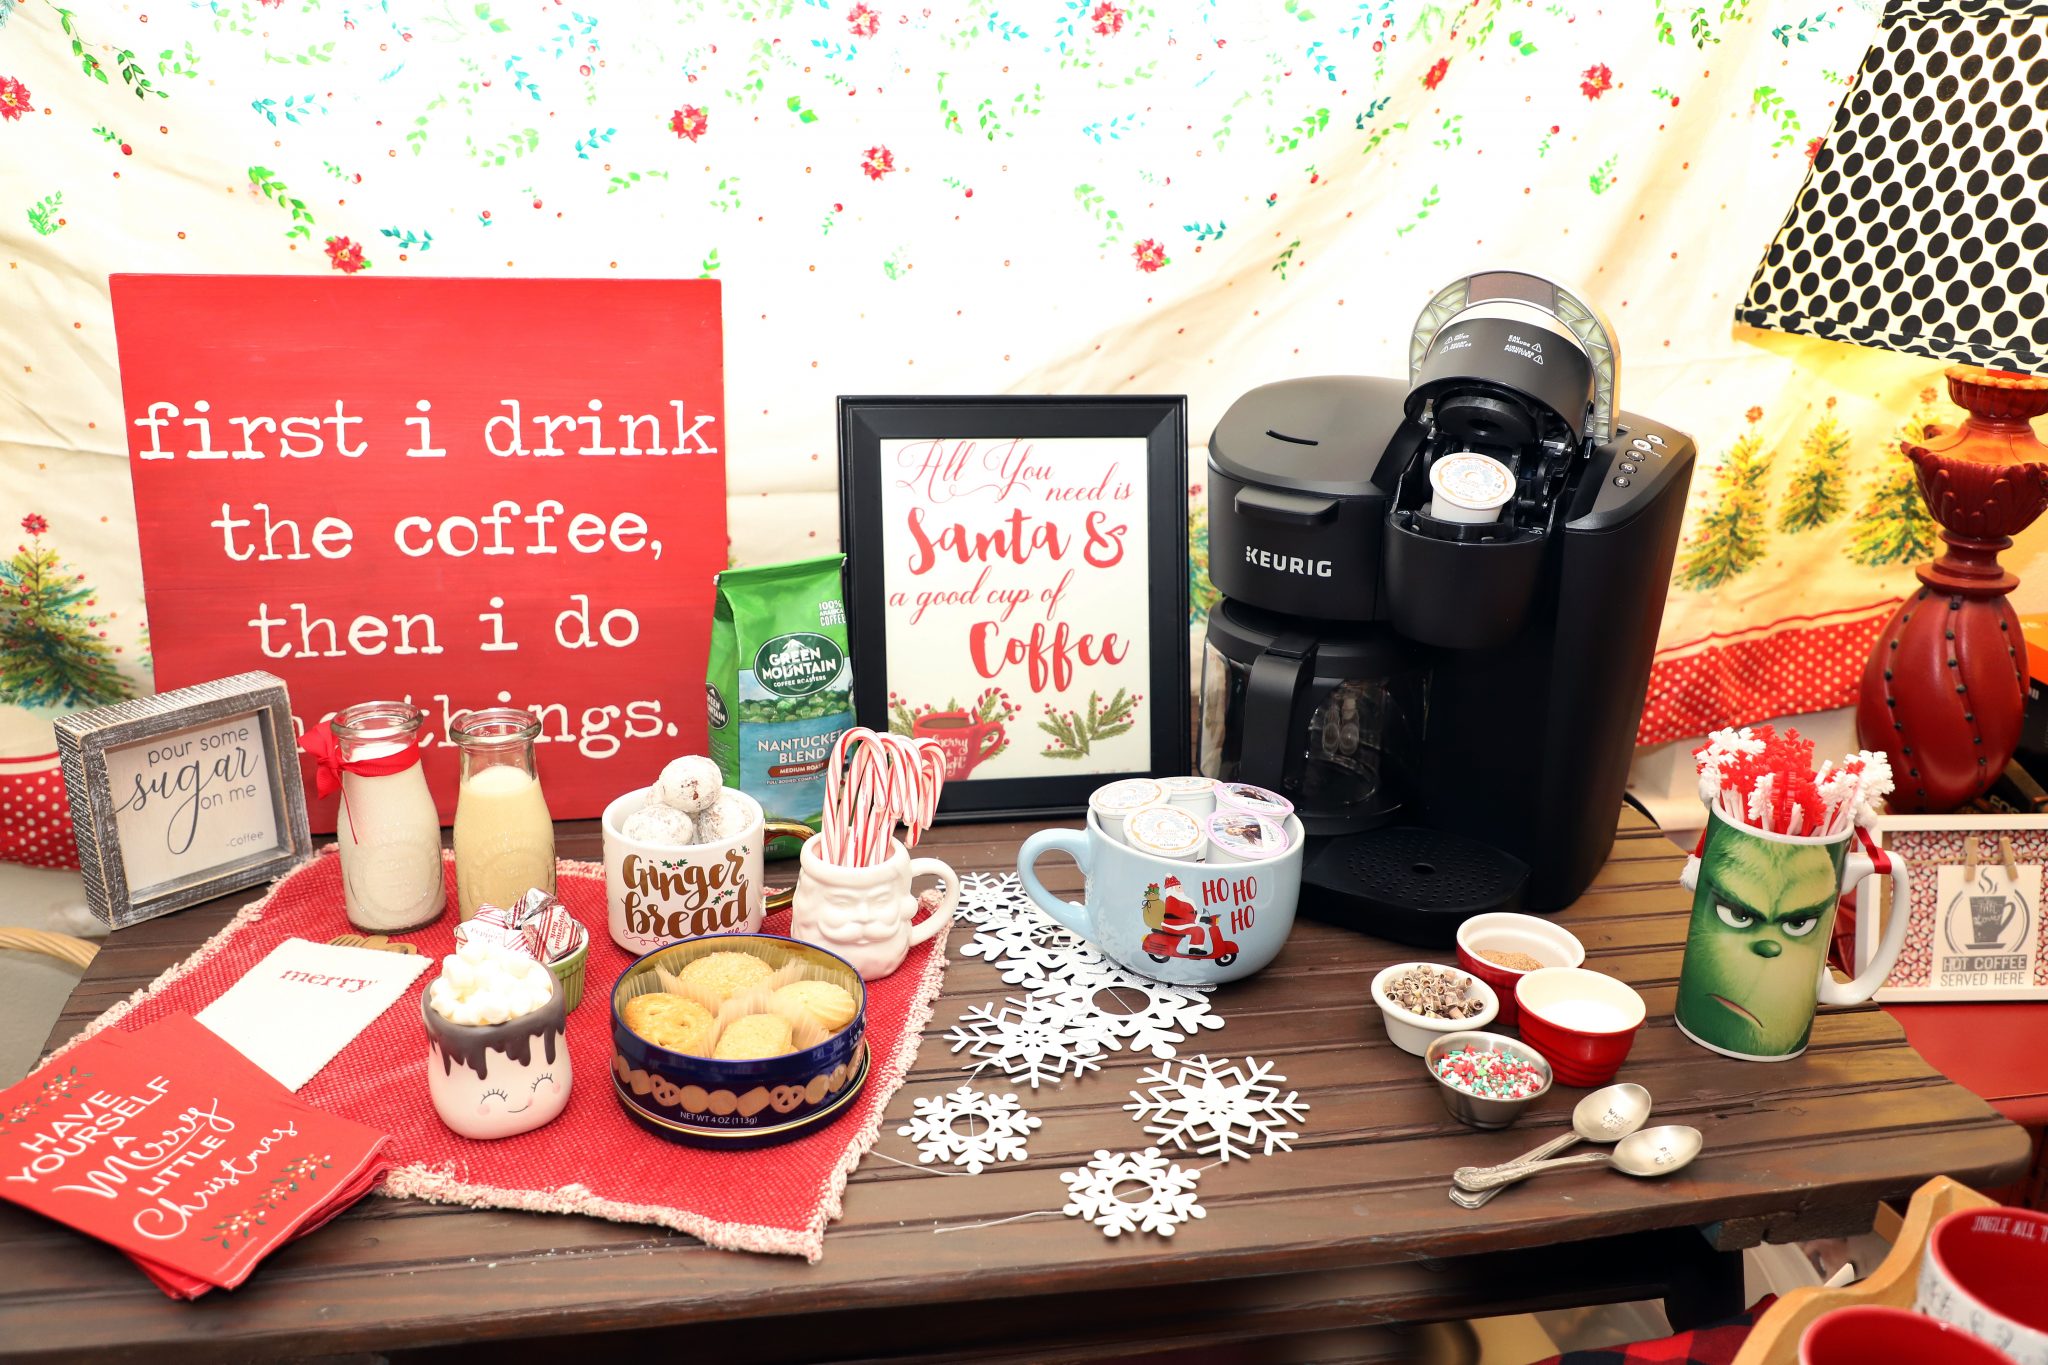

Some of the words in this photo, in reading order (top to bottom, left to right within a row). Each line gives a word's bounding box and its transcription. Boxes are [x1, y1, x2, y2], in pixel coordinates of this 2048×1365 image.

[134, 400, 370, 460] first
[404, 400, 446, 457] i
[484, 399, 718, 456] drink
[896, 439, 976, 503] All
[950, 438, 1054, 503] You
[1045, 462, 1120, 501] need
[1114, 482, 1135, 501] is
[211, 503, 354, 561] the
[394, 501, 664, 560] coffee,
[908, 507, 1071, 575] Santa
[1084, 510, 1127, 568] &
[1245, 545, 1332, 577] KEURIG
[818, 600, 842, 611] 100%
[889, 591, 909, 607] a
[908, 565, 992, 625] good
[987, 588, 1033, 622] cup
[1040, 569, 1074, 621] of
[248, 603, 444, 659] then
[479, 597, 518, 652] i
[554, 595, 640, 649] do
[820, 613, 846, 627] COFFEE
[762, 658, 836, 680] MOUNTAIN
[768, 647, 821, 667] GREEN
[970, 621, 1130, 693] Coffee
[773, 680, 795, 688] COFFEE
[796, 675, 827, 686] ROASTERS
[147, 741, 193, 767] pour
[200, 727, 249, 752] some
[758, 728, 843, 751] NANTUCKET
[779, 748, 826, 764] BLEND
[779, 766, 806, 774] MEDIUM
[806, 762, 824, 772] ROAST
[114, 747, 259, 854] sugar
[200, 792, 223, 810] on
[229, 783, 256, 802] me
[622, 848, 745, 909] Ginger
[1202, 878, 1229, 906] HO
[1233, 876, 1258, 906] HO
[621, 880, 751, 938] bread
[1231, 905, 1255, 934] HO
[280, 969, 379, 993] merry
[1941, 973, 1987, 987] SERVED
[1994, 972, 2025, 985] HERE
[1943, 956, 1968, 971] HOT
[1974, 956, 2026, 970] COFFEE
[5, 1075, 171, 1184] YOURSELF
[19, 1090, 121, 1153] HAVE
[680, 1111, 697, 1121] NET
[697, 1114, 710, 1123] WT
[711, 1115, 717, 1123] 4
[717, 1116, 731, 1124] OZ
[731, 1115, 758, 1125] (113g)
[52, 1097, 236, 1200] Merry
[113, 1135, 137, 1151] A
[133, 1120, 298, 1241] Christmas
[137, 1135, 226, 1197] LITTLE
